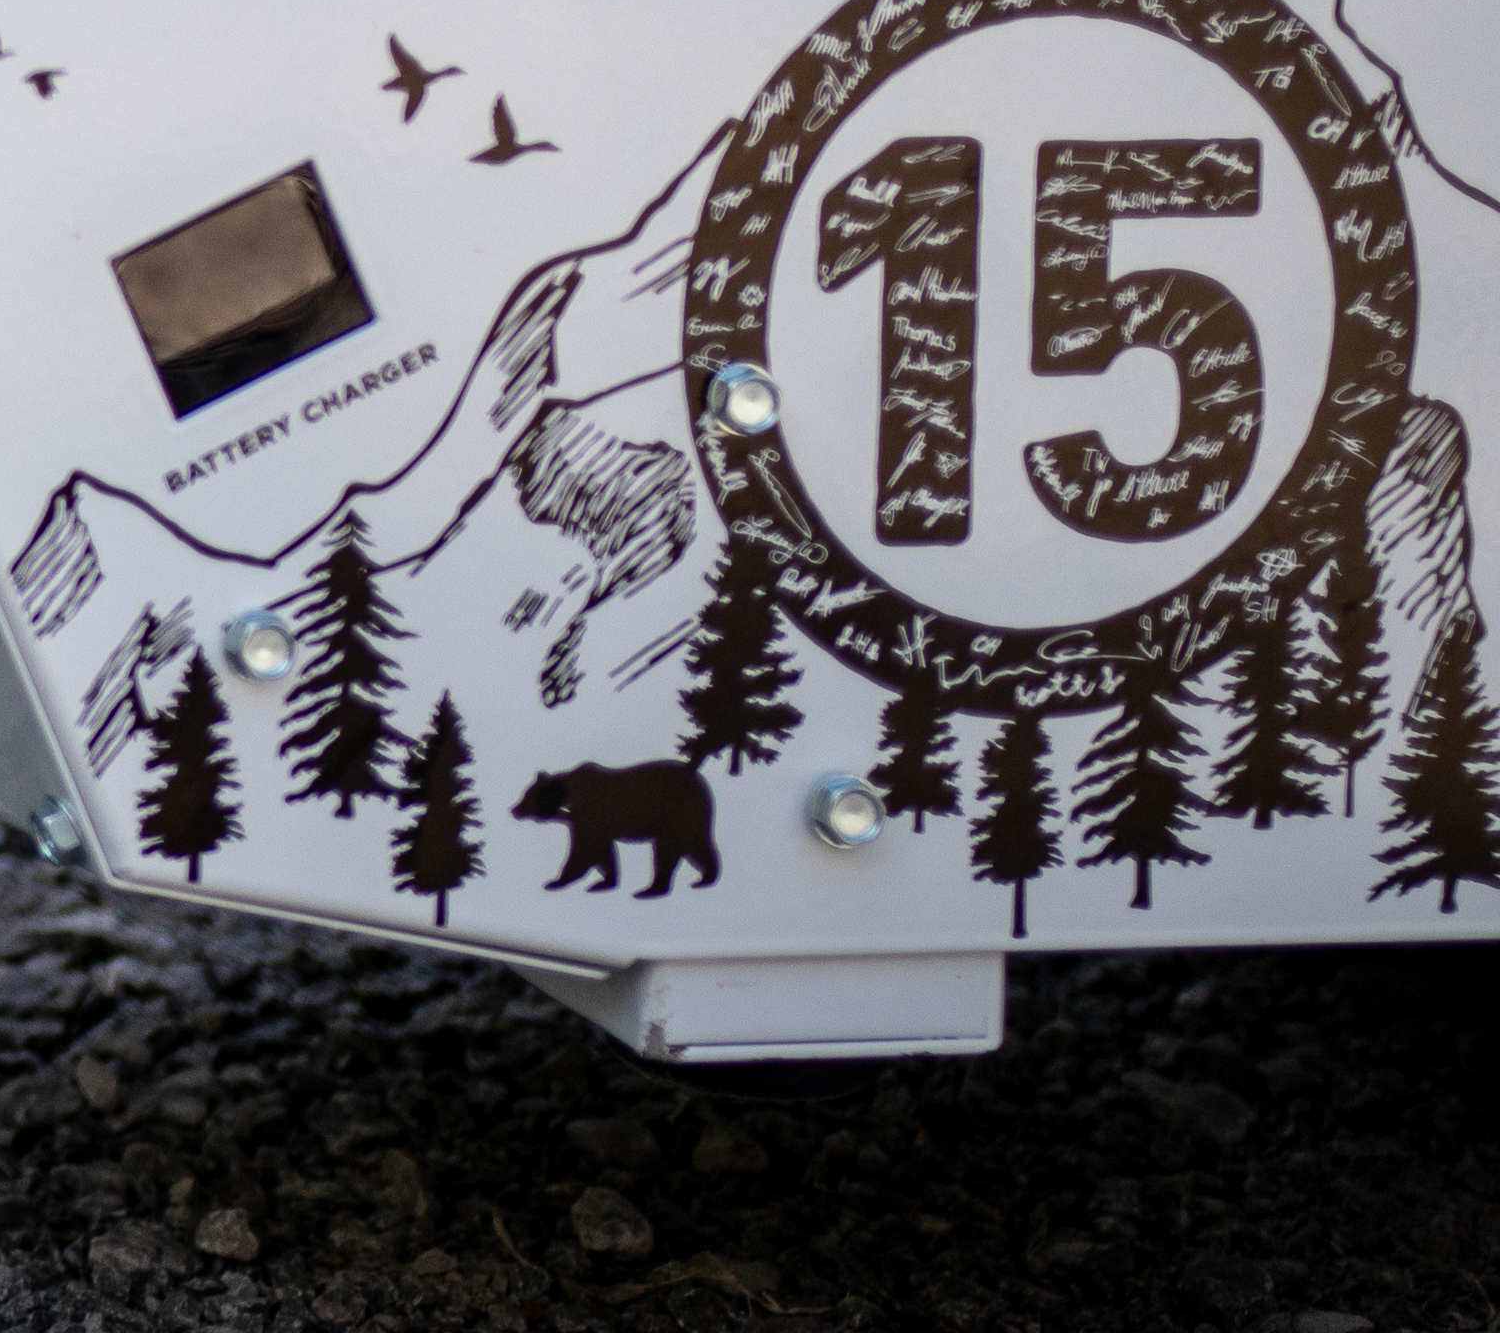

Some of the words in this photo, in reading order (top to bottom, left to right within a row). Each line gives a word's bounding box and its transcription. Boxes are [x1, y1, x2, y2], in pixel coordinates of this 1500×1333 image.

[165, 414, 291, 494] BATTERY
[301, 343, 440, 423] CHARGER
[817, 136, 1263, 545] 15
